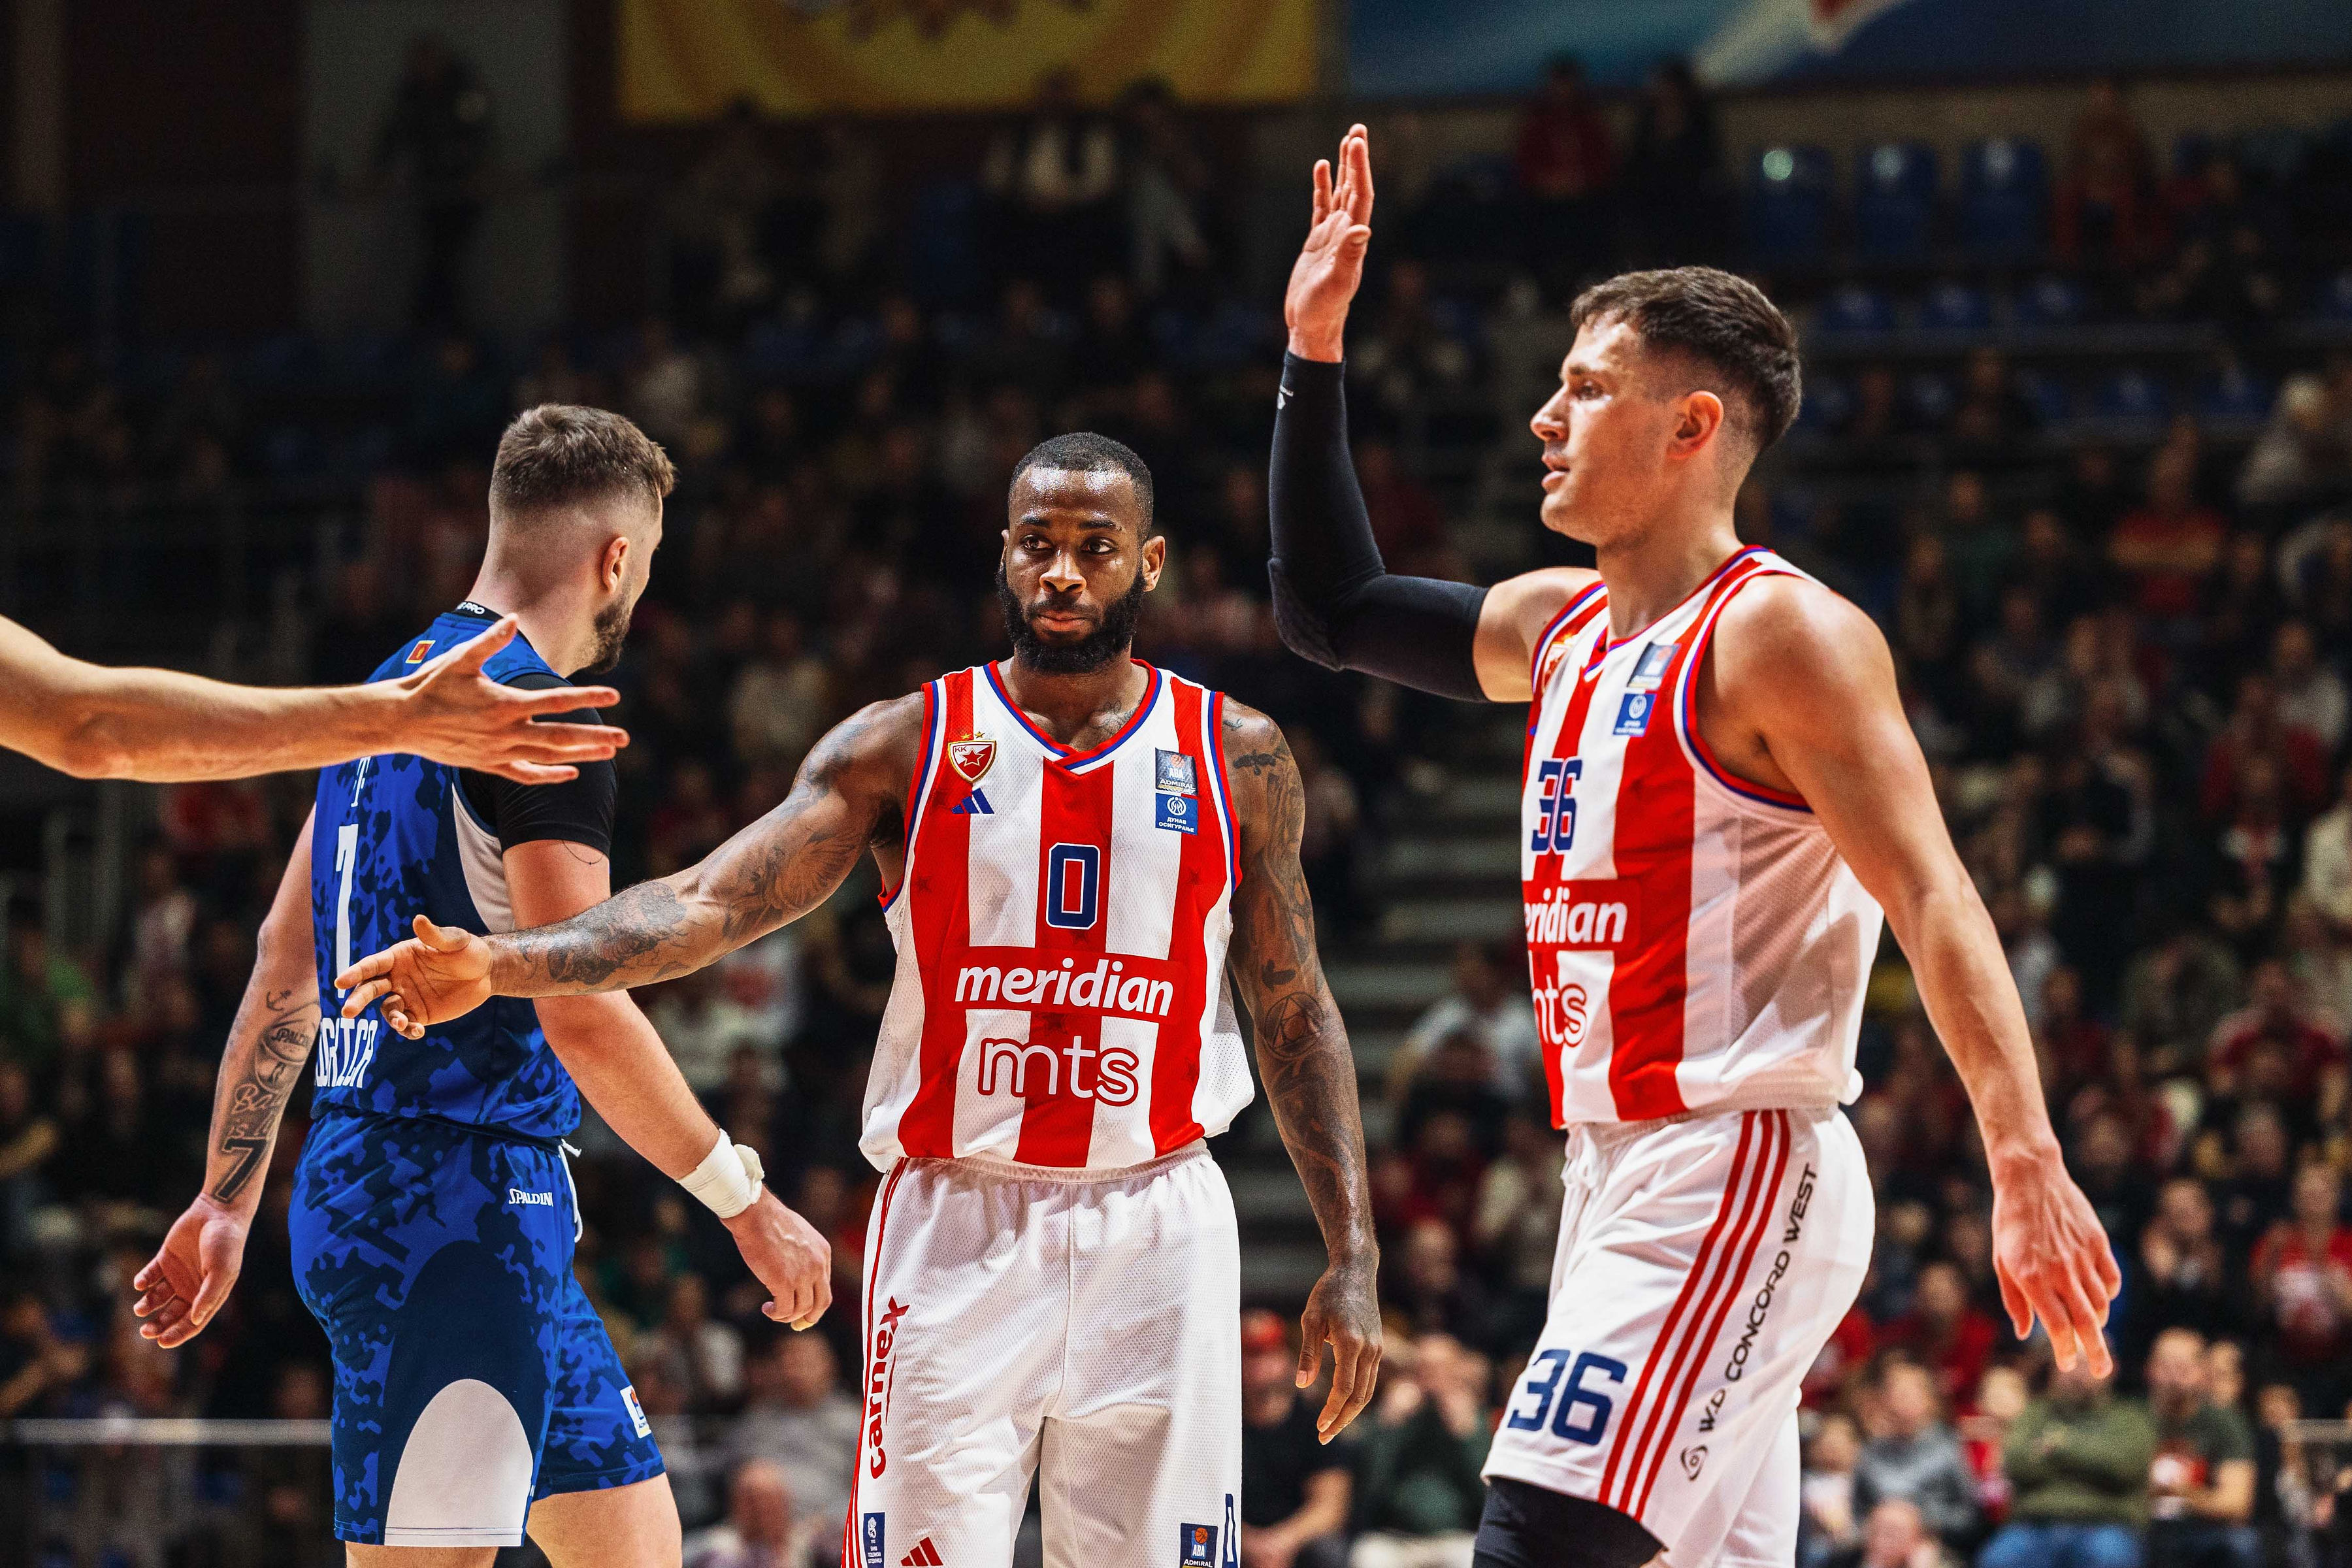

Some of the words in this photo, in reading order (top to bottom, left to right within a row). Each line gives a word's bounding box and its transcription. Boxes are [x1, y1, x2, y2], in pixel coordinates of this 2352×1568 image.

[1160, 779, 1196, 790] ADMIRAL
[1167, 817, 1187, 825] ДУНАВ
[1531, 758, 1582, 853] 36
[336, 823, 359, 999] 7
[1046, 843, 1100, 930] 0
[955, 957, 1174, 1017] meridian
[979, 1036, 1139, 1105] mts
[1725, 1250, 1791, 1382] CONCORD
[1783, 1162, 1818, 1243] WEST
[869, 1295, 910, 1479] carnex
[1507, 1348, 1628, 1446] 36
[1183, 1559, 1213, 1568] ADMIRAL
[1192, 1544, 1205, 1558] ABA
